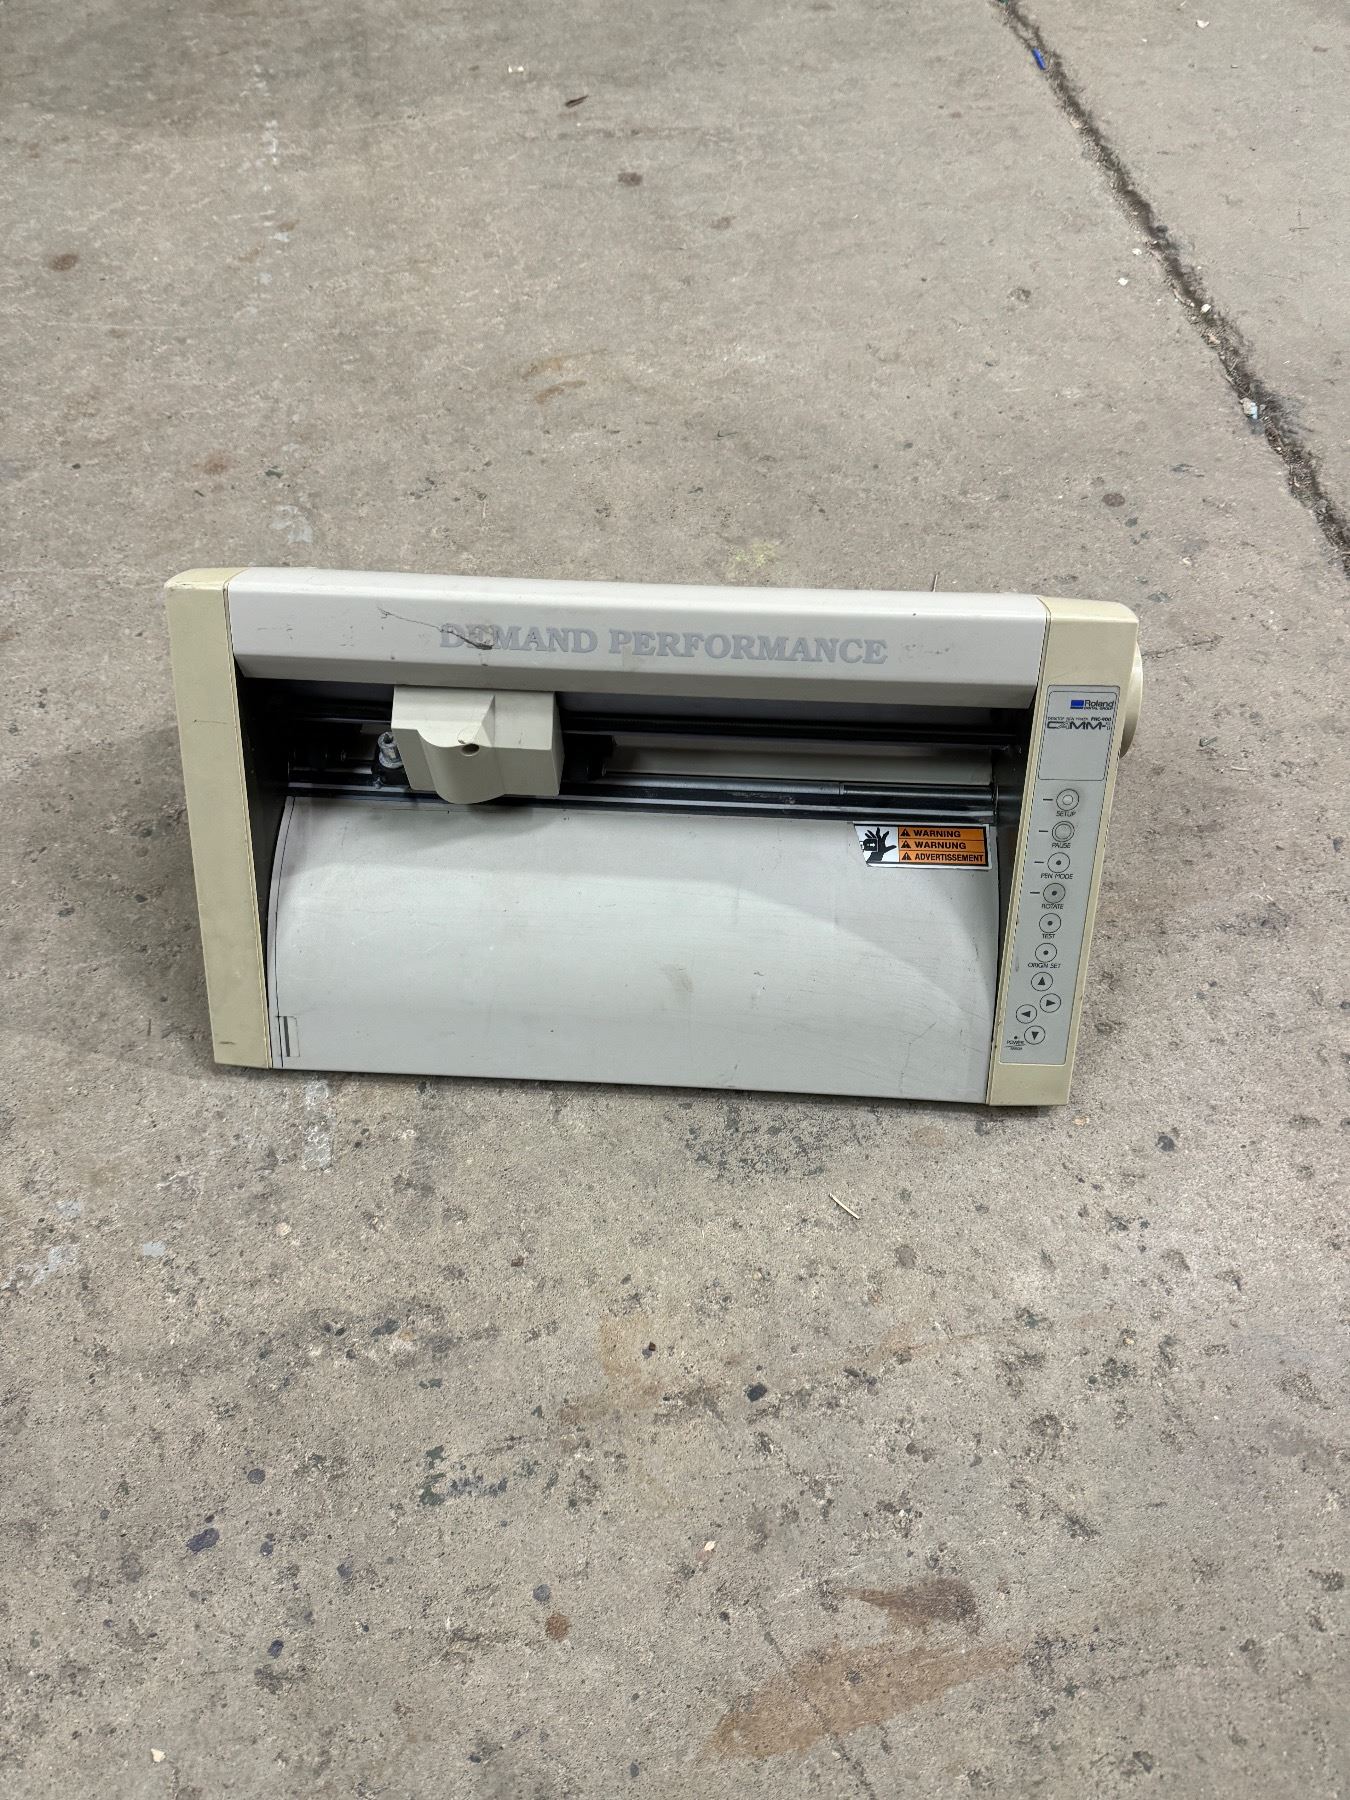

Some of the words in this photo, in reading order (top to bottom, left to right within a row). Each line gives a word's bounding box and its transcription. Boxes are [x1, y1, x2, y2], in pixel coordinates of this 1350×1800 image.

[608, 628, 889, 665] PERFORMANCE
[913, 829, 961, 838] WARNING
[914, 841, 967, 850] WARNUNG
[914, 853, 984, 862] ADVERTISSEMENT
